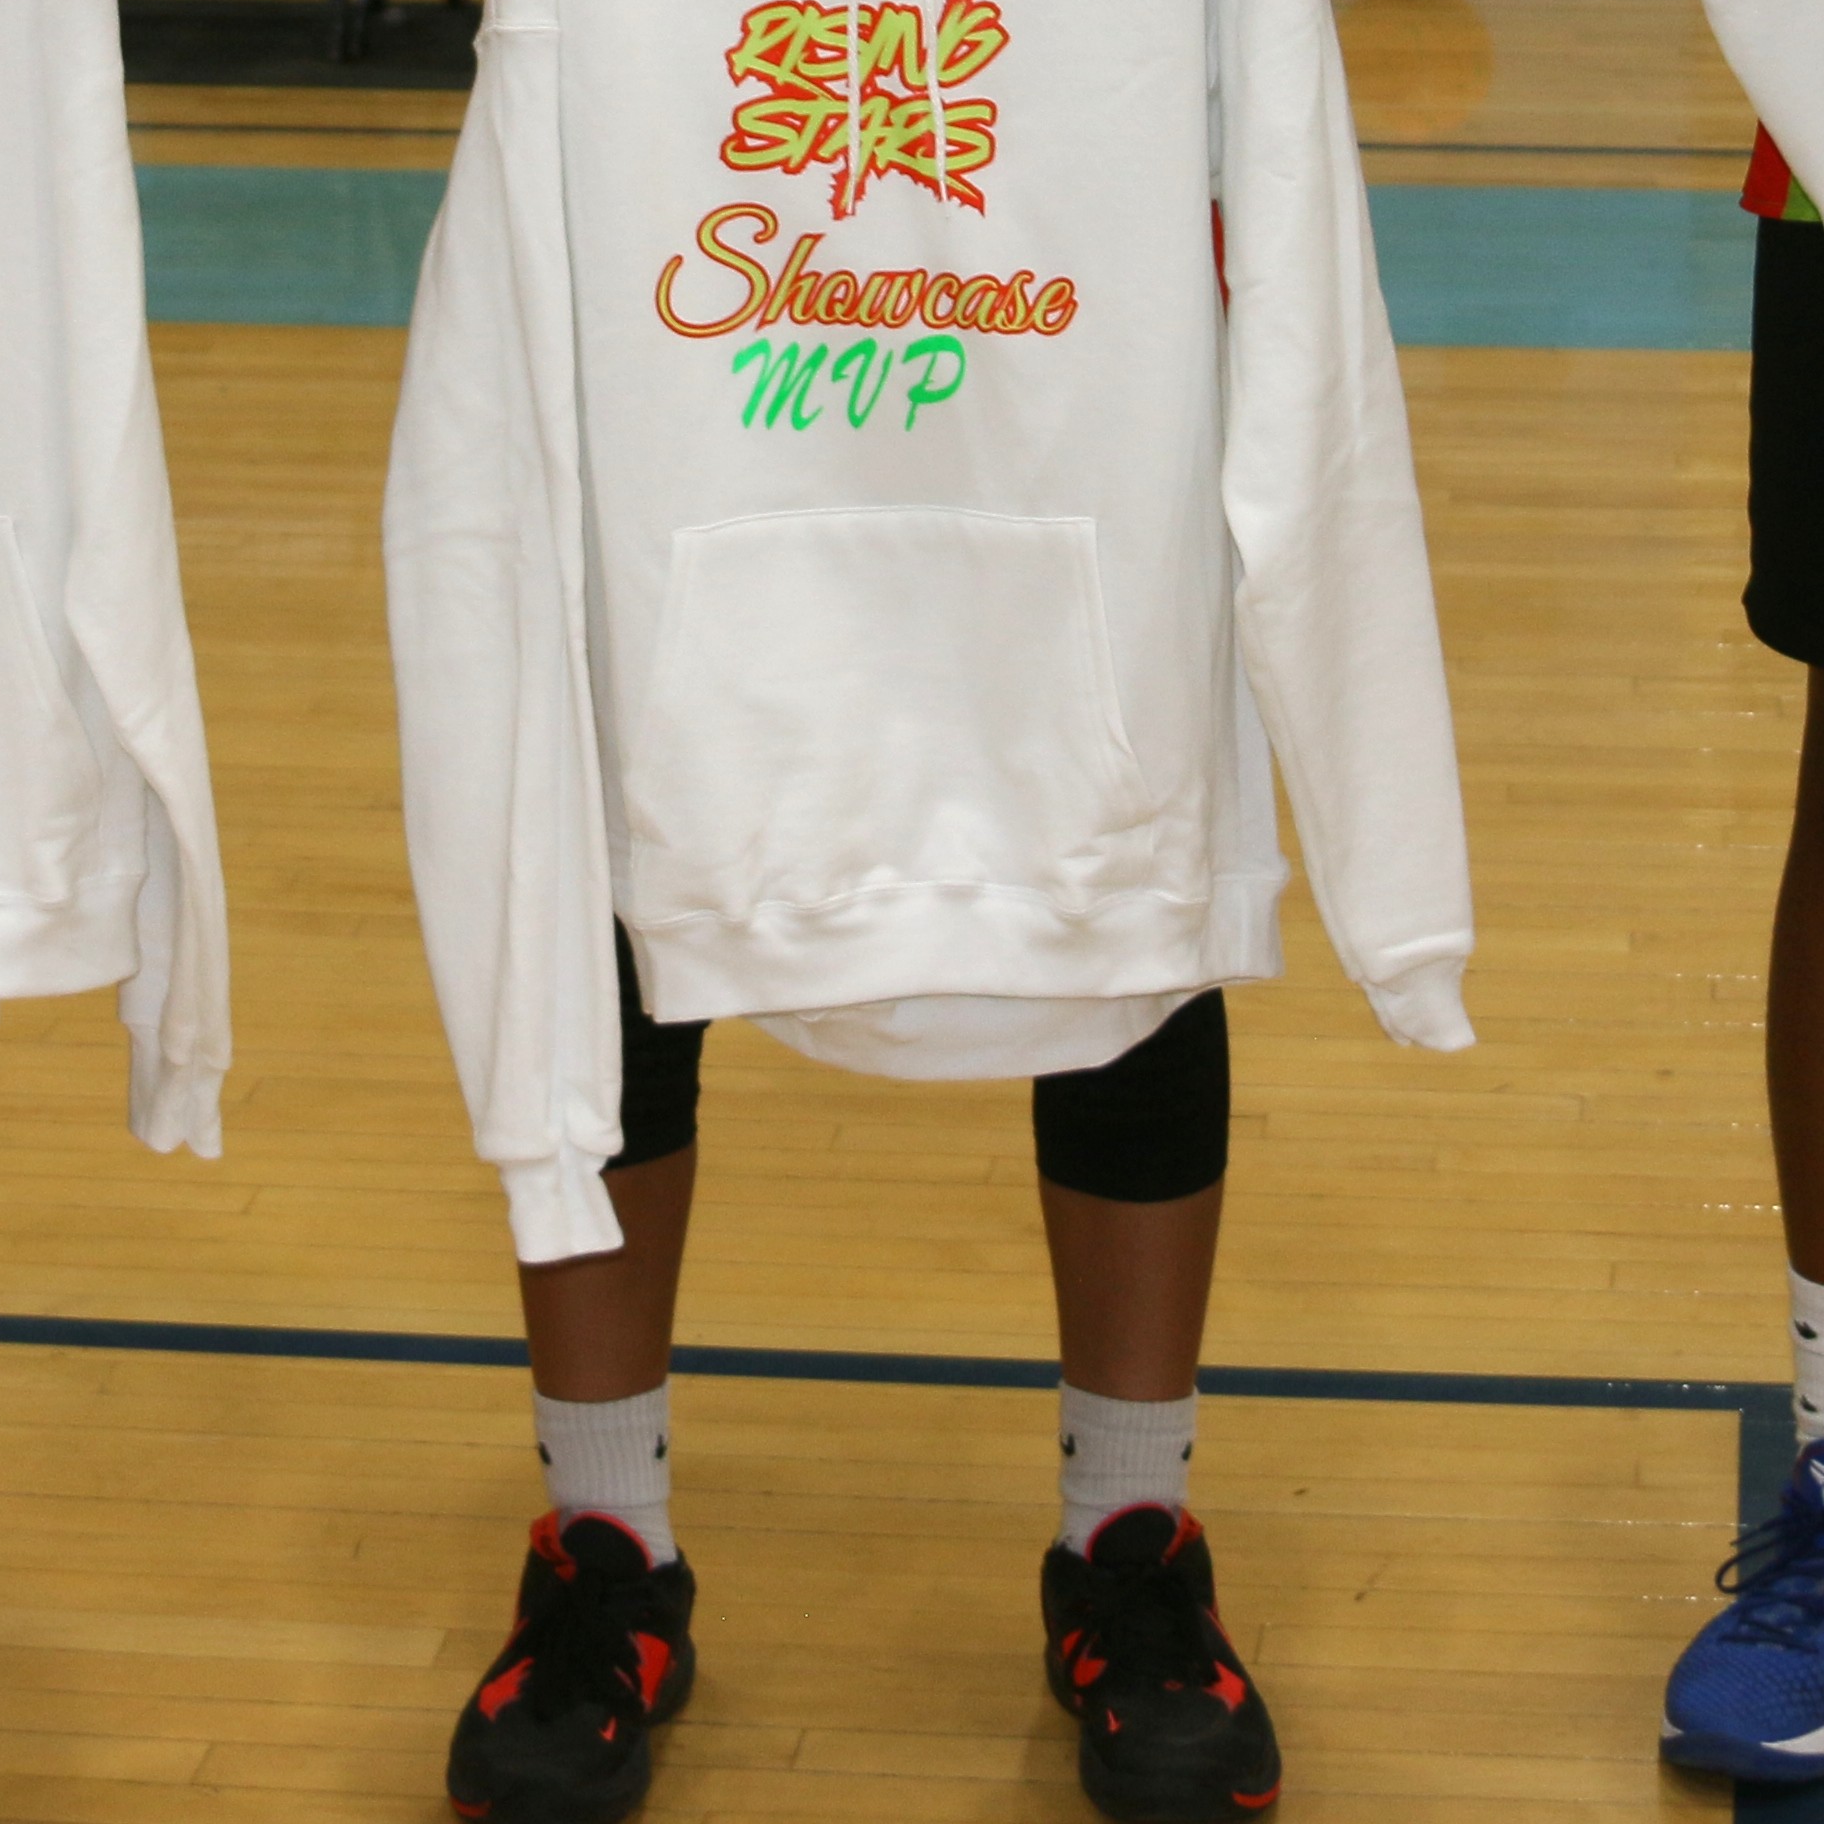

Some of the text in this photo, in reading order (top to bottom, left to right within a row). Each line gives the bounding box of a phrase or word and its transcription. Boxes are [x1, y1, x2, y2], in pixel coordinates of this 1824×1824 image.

[719, 96, 999, 221] STARS
[655, 203, 1079, 339] Showcase
[731, 335, 967, 433] MVP
